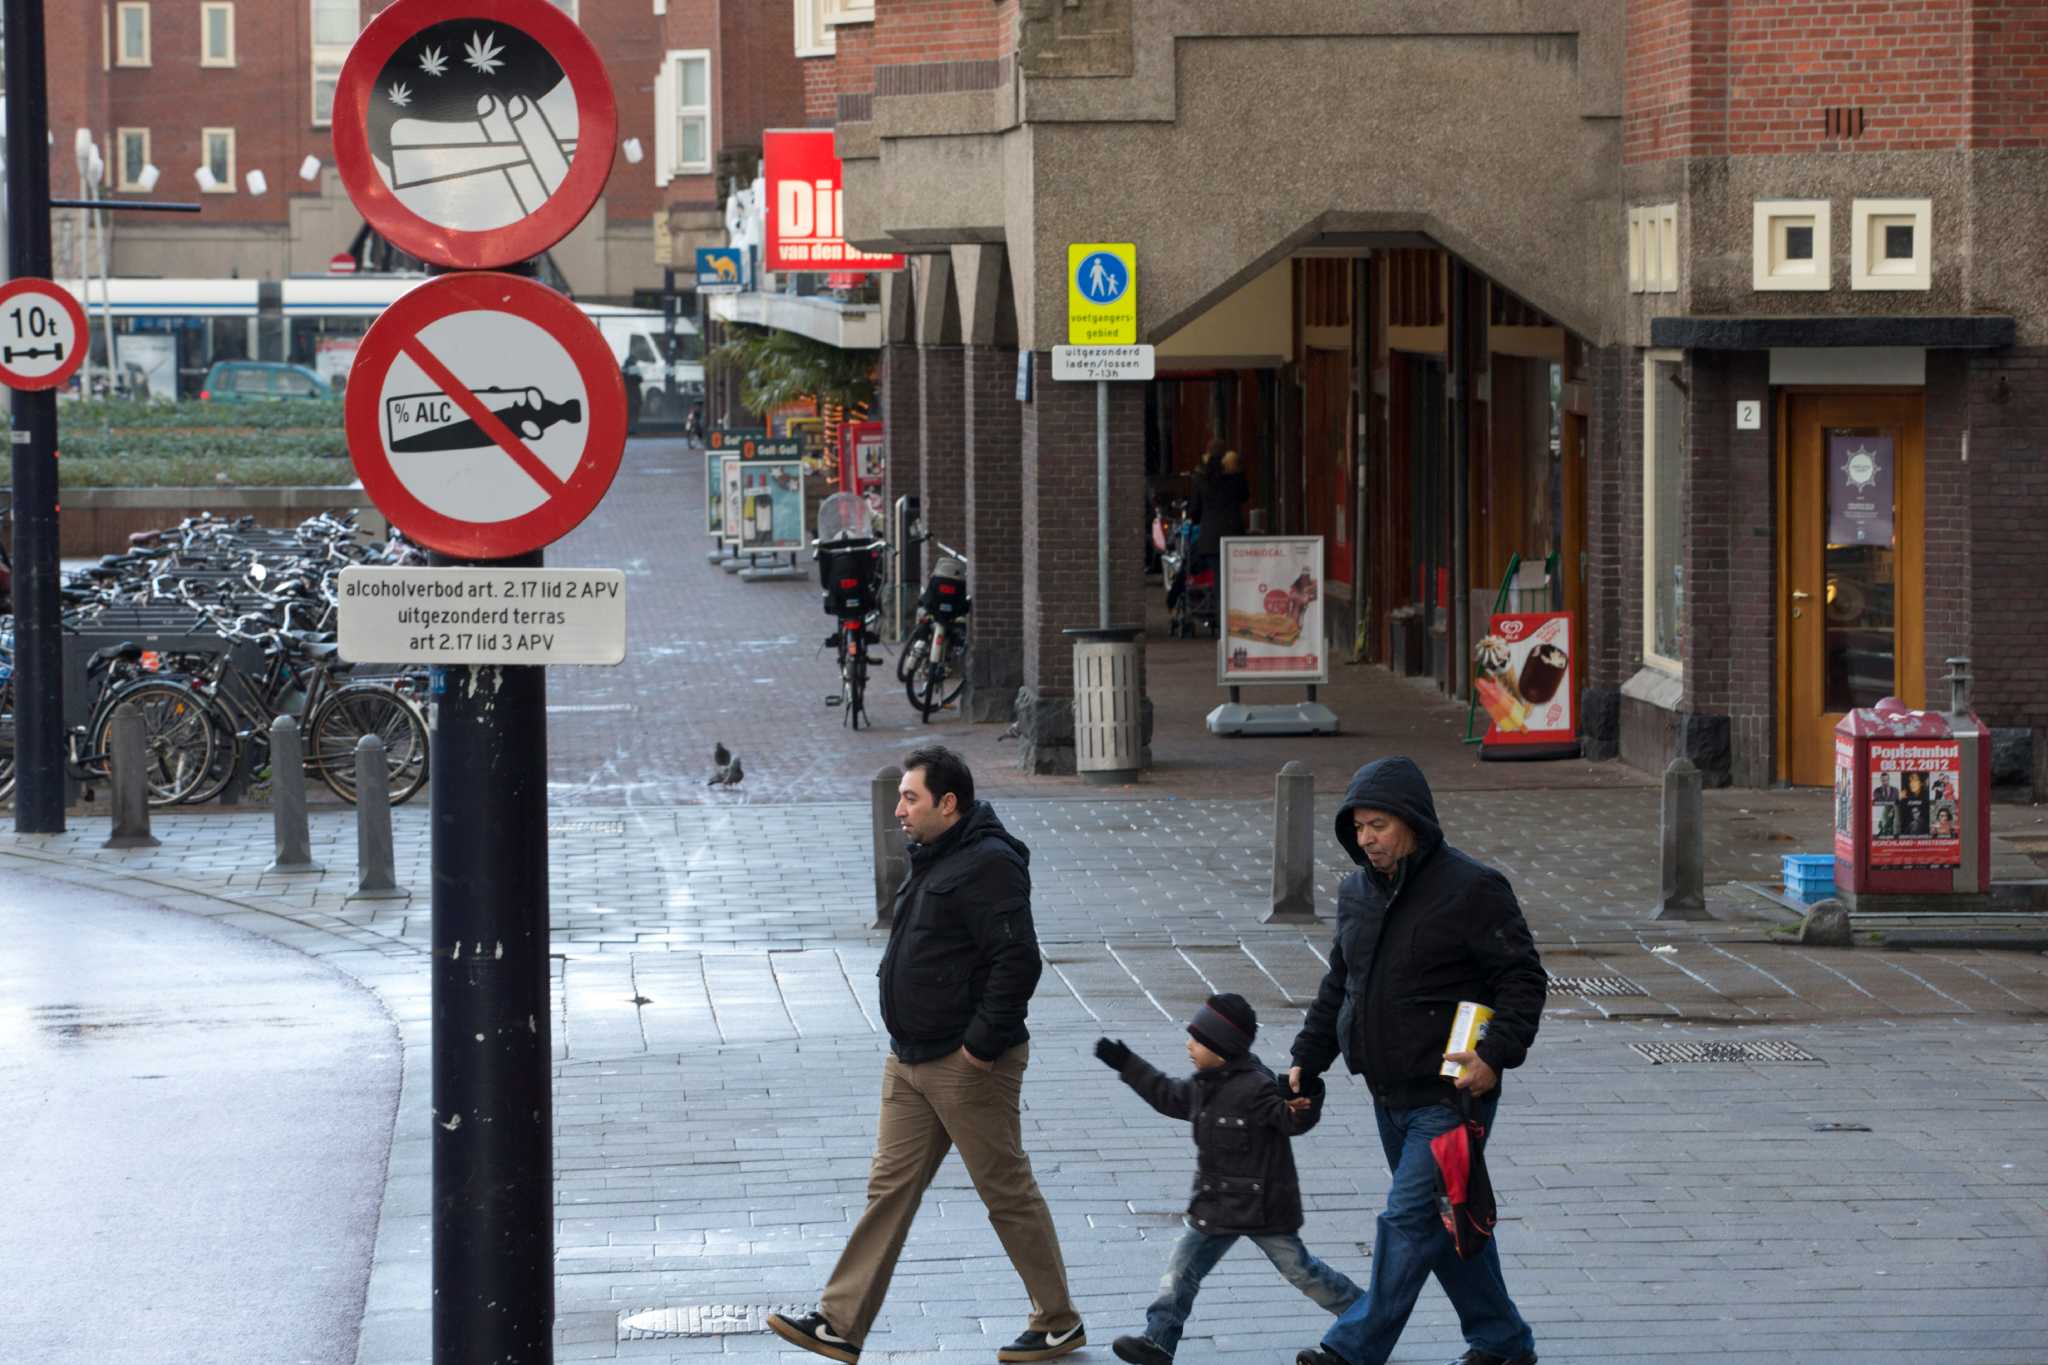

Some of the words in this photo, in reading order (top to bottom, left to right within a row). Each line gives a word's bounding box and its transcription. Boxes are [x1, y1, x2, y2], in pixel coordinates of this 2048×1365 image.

[777, 179, 843, 238] Di
[778, 245, 809, 260] van
[811, 243, 842, 260] den
[1086, 328, 1119, 339] gebied
[1065, 347, 1140, 358] uitgezonderd
[1065, 359, 1140, 368] laden/lossen
[1088, 369, 1119, 378] 7-13h
[394, 403, 410, 423] %
[415, 401, 451, 423] ALC
[1743, 406, 1752, 422] 2
[346, 580, 463, 598] alcoholverbod
[468, 582, 498, 598] art.
[503, 581, 536, 599] 2.17
[542, 581, 561, 598] lid
[566, 582, 577, 598] 2
[581, 582, 619, 599] APV
[398, 607, 508, 628] uitgezonderd
[513, 609, 565, 625] terras
[409, 635, 434, 650] art
[439, 634, 473, 650] 2.17
[477, 634, 496, 650] lid
[502, 635, 512, 650] 3
[516, 634, 554, 651] APV
